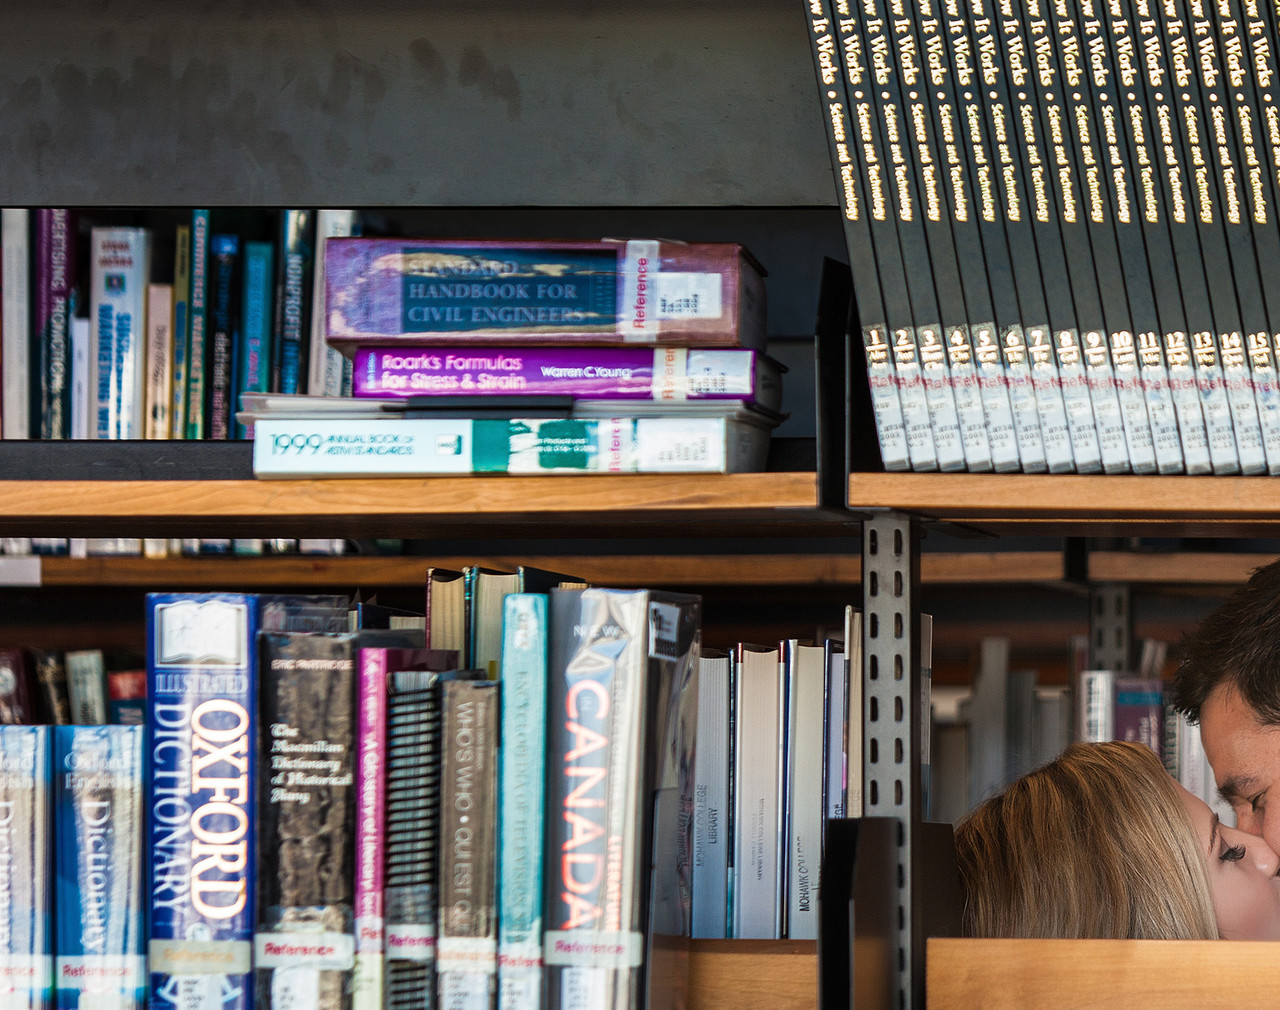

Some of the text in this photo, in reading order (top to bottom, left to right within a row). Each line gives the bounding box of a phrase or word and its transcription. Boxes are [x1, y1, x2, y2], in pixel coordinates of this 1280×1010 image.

[812, 18, 859, 221] It Works Science and Technology
[867, 18, 913, 222] It Works Science and Technology
[949, 18, 996, 223] It Works Science and Technology
[408, 260, 519, 276] STANDARD
[408, 284, 577, 300] HANDBOOK FOR
[633, 257, 648, 328] Reference
[408, 307, 585, 323] CIVIL ENGINEERS
[870, 330, 880, 345] 1
[979, 330, 991, 346] 5
[1032, 330, 1044, 346] 7
[1112, 331, 1131, 347] 10
[1167, 331, 1185, 347] 12
[1249, 332, 1267, 348] 15
[382, 354, 442, 371] Roark's
[445, 354, 523, 371] Formulas
[381, 371, 526, 389] for Stress & Strain
[540, 366, 583, 378] Warren
[270, 433, 323, 455] 1999
[454, 766, 472, 810] WHO
[152, 702, 193, 912] DICTIONARY
[190, 698, 249, 920] OXFORD
[561, 679, 611, 930] CANADA
[708, 808, 718, 844] LIBRARY
[453, 863, 472, 894] EST
